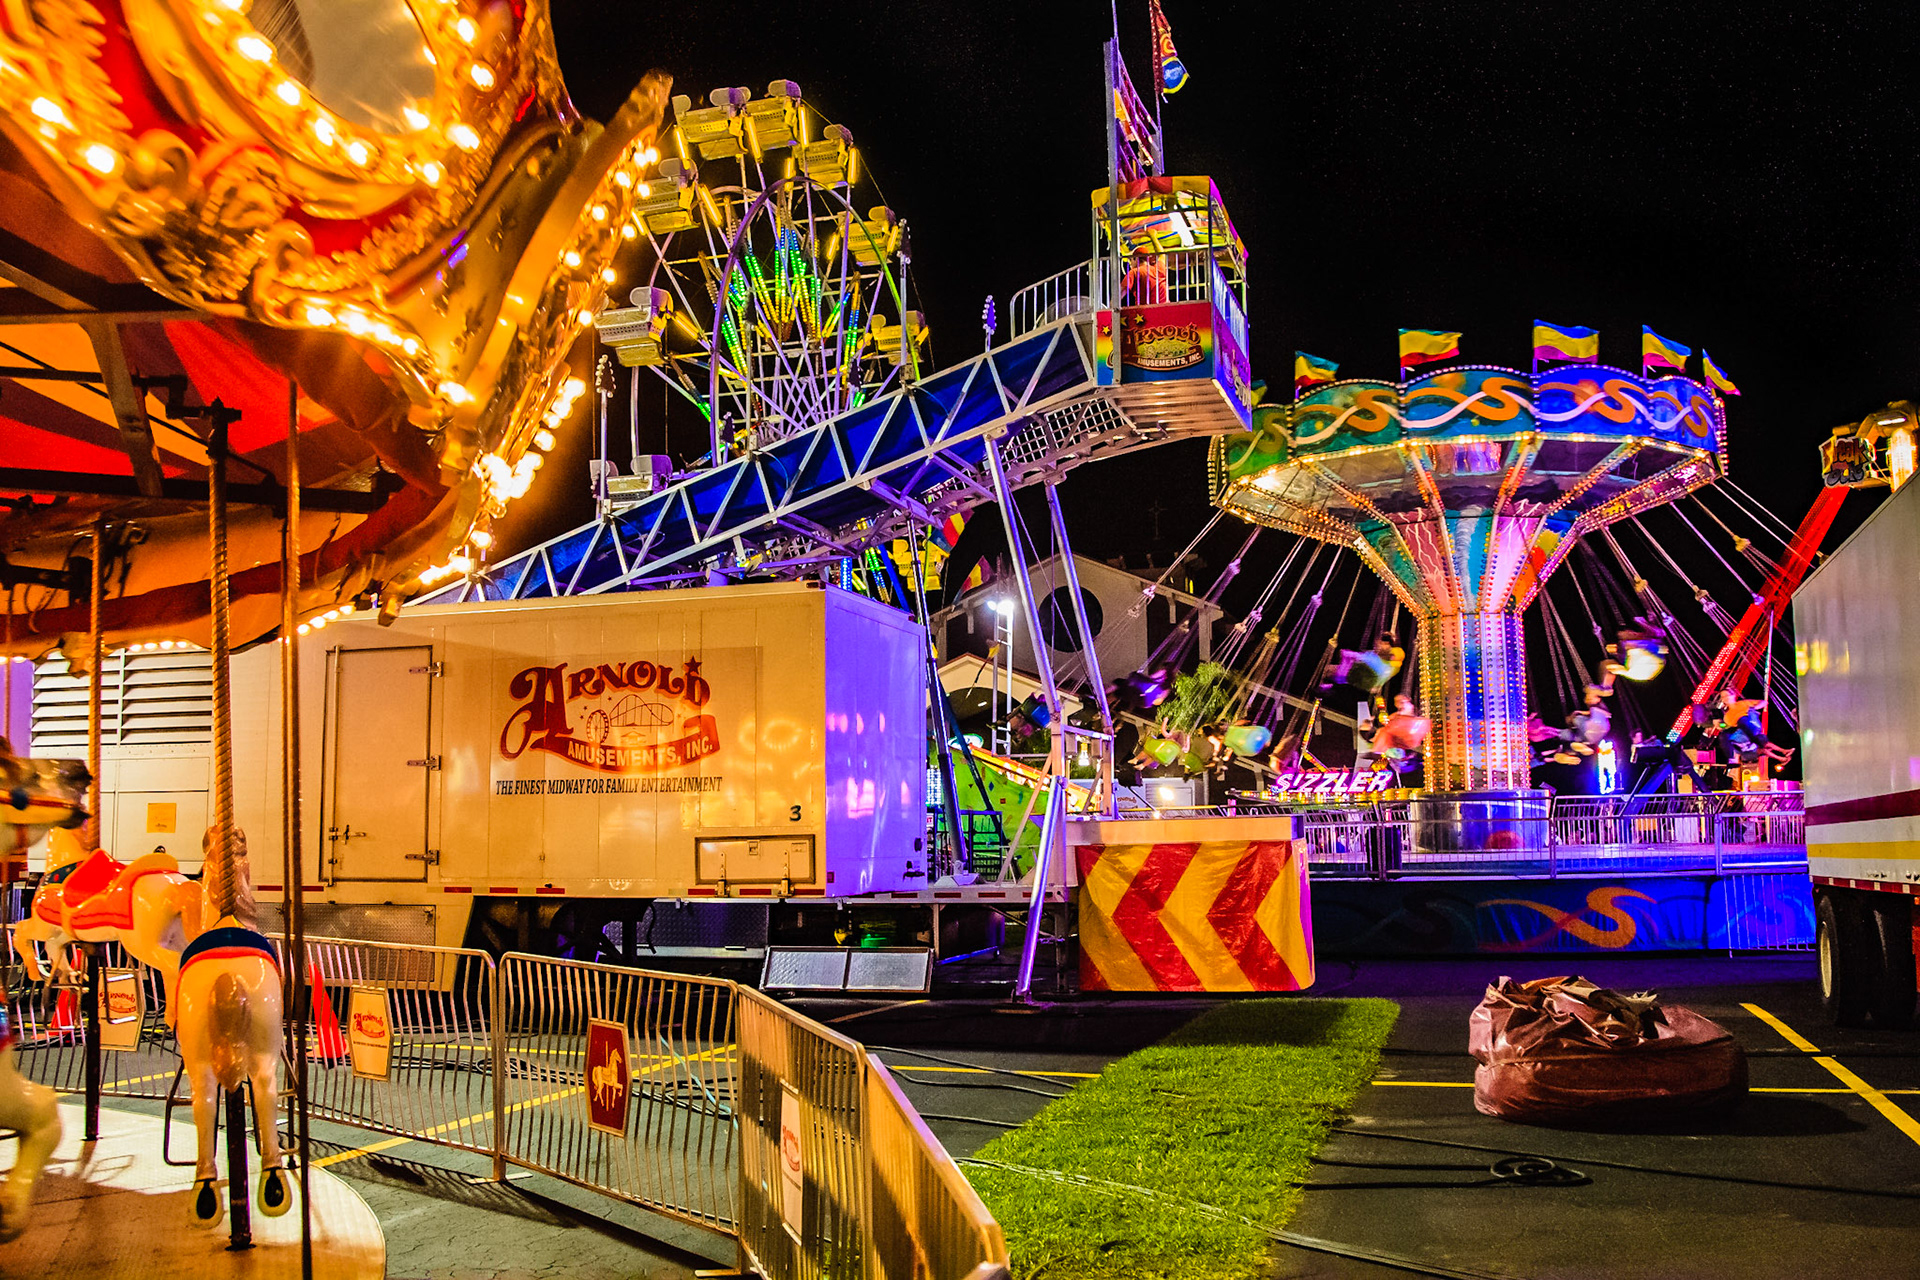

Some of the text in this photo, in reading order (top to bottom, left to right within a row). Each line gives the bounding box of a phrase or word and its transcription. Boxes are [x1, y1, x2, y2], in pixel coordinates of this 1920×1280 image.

[1137, 352, 1202, 367] AMUSEMENTS, INC.
[500, 656, 711, 761] ARNOLD
[567, 735, 713, 766] AMUSEMENTS, INC.
[496, 776, 722, 795] THE FINEST MIDWAY FOR FAMILY ENTERTAINMENT
[1276, 770, 1393, 793] SIZZLER
[789, 805, 801, 821] 3
